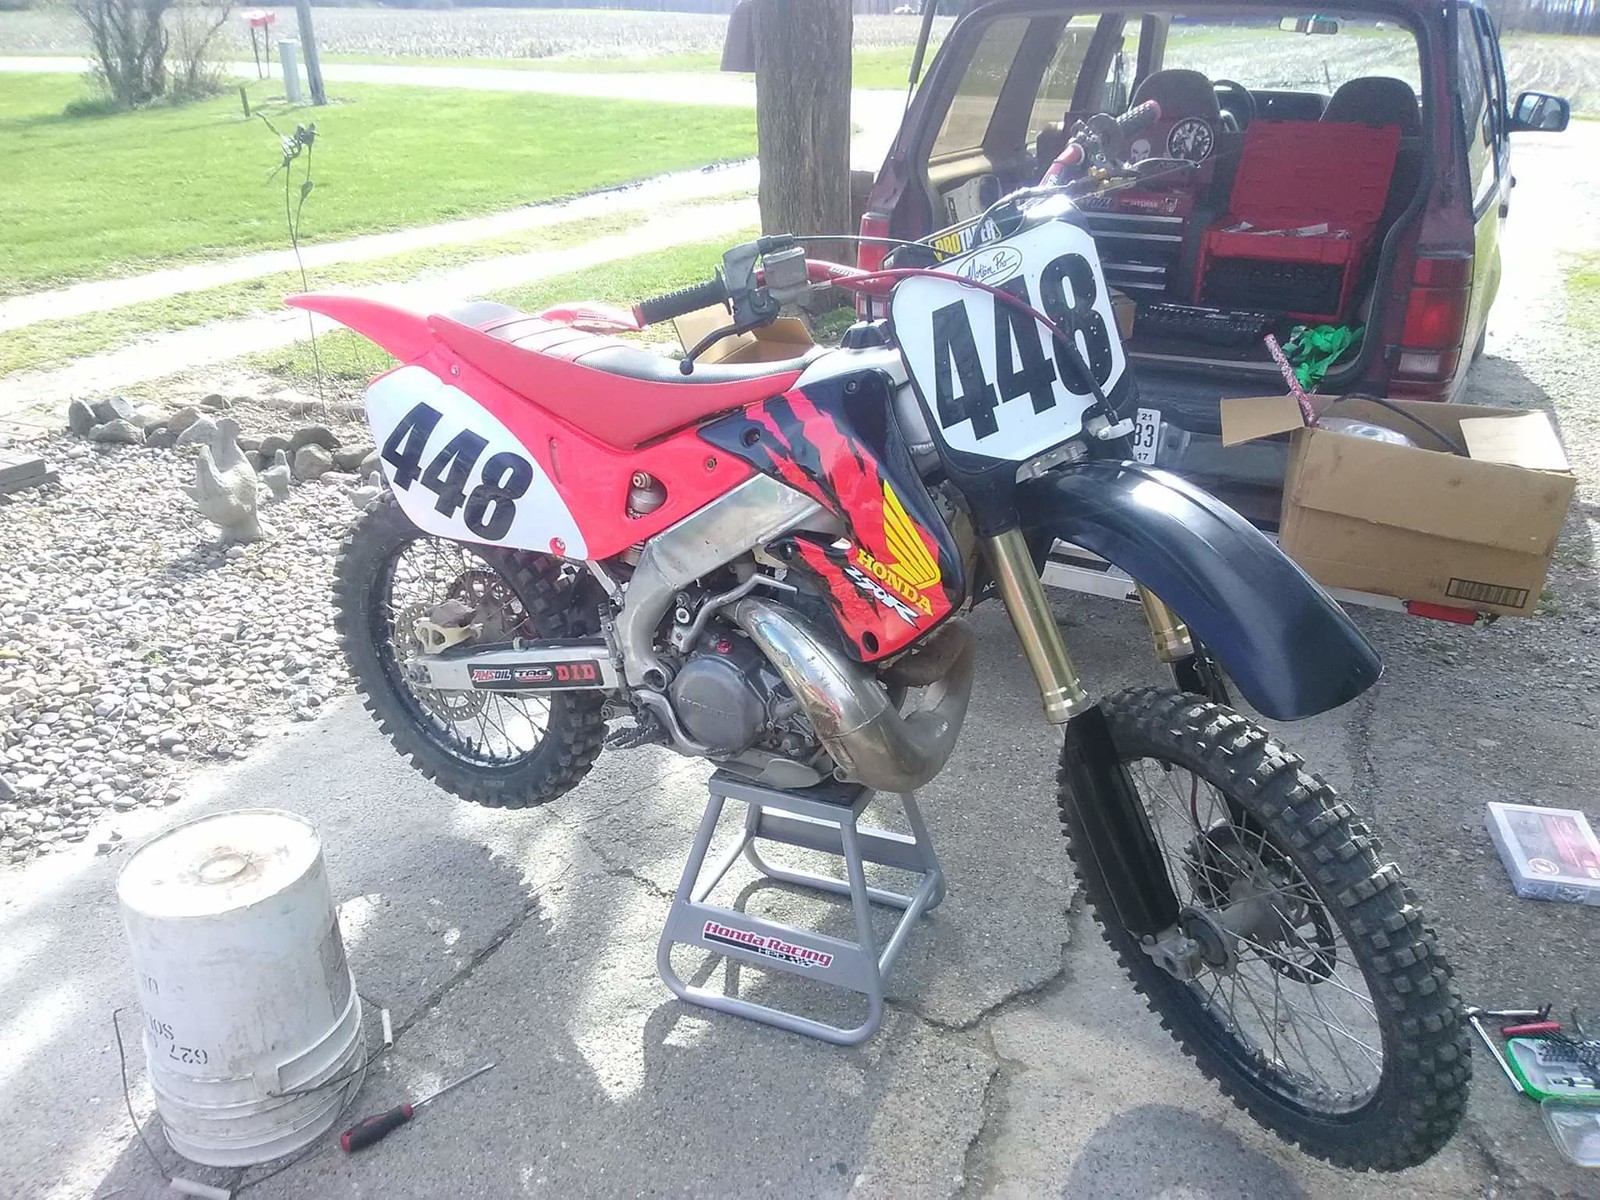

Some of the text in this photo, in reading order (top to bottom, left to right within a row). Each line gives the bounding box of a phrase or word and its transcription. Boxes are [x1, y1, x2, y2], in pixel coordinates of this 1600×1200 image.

[965, 251, 1015, 282] Motion Pro
[931, 253, 1113, 441] 448
[1141, 412, 1153, 421] 21
[380, 401, 534, 541] 448
[1137, 452, 1149, 461] 17
[856, 549, 934, 616] HONDA
[472, 669, 511, 682] AMSOIL
[704, 922, 765, 947] Honda
[767, 940, 833, 967] Racing
